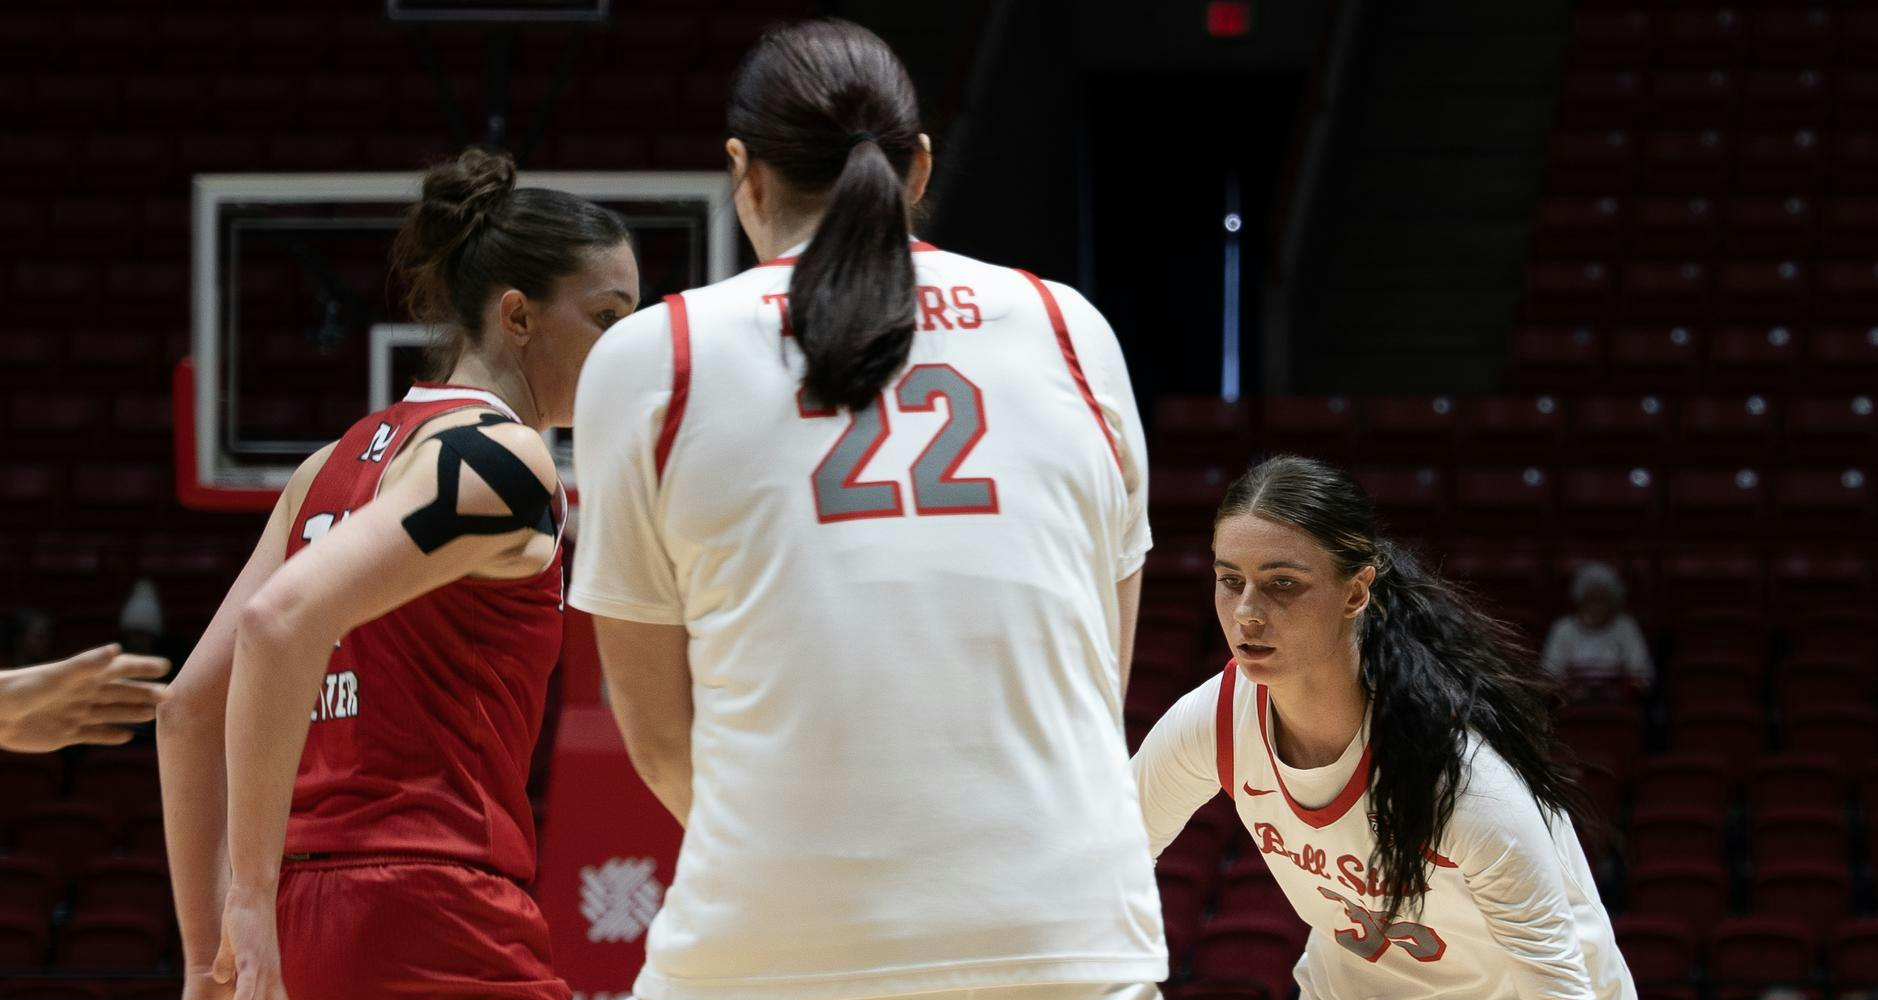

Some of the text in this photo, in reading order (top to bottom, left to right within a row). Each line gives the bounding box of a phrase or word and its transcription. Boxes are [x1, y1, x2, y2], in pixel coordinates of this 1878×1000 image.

[795, 363, 1001, 524] 22
[1254, 822, 1331, 880] Ball
[1336, 843, 1458, 898] Sta
